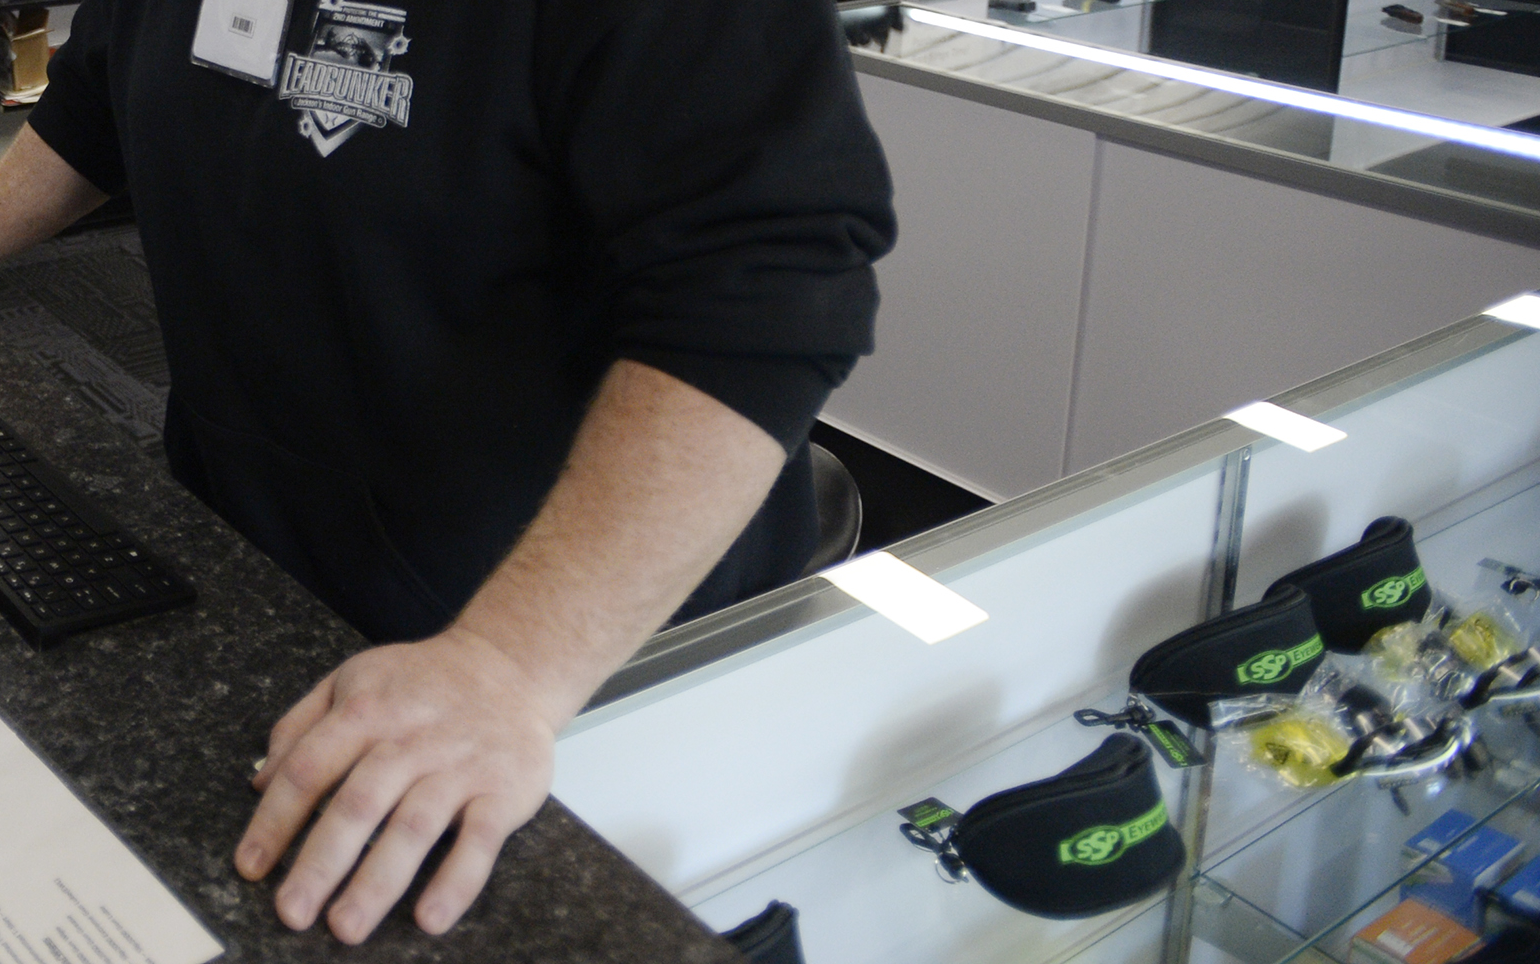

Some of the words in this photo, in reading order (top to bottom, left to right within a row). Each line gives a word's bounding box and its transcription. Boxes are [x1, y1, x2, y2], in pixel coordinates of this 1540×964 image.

[346, 15, 385, 27] AMENDMENT
[280, 53, 414, 127] LEADBUNKER
[343, 104, 356, 115] Gun
[357, 107, 377, 123] Range
[1374, 581, 1406, 604] SSP
[1250, 654, 1287, 679] SSP
[1077, 830, 1120, 861] SSP
